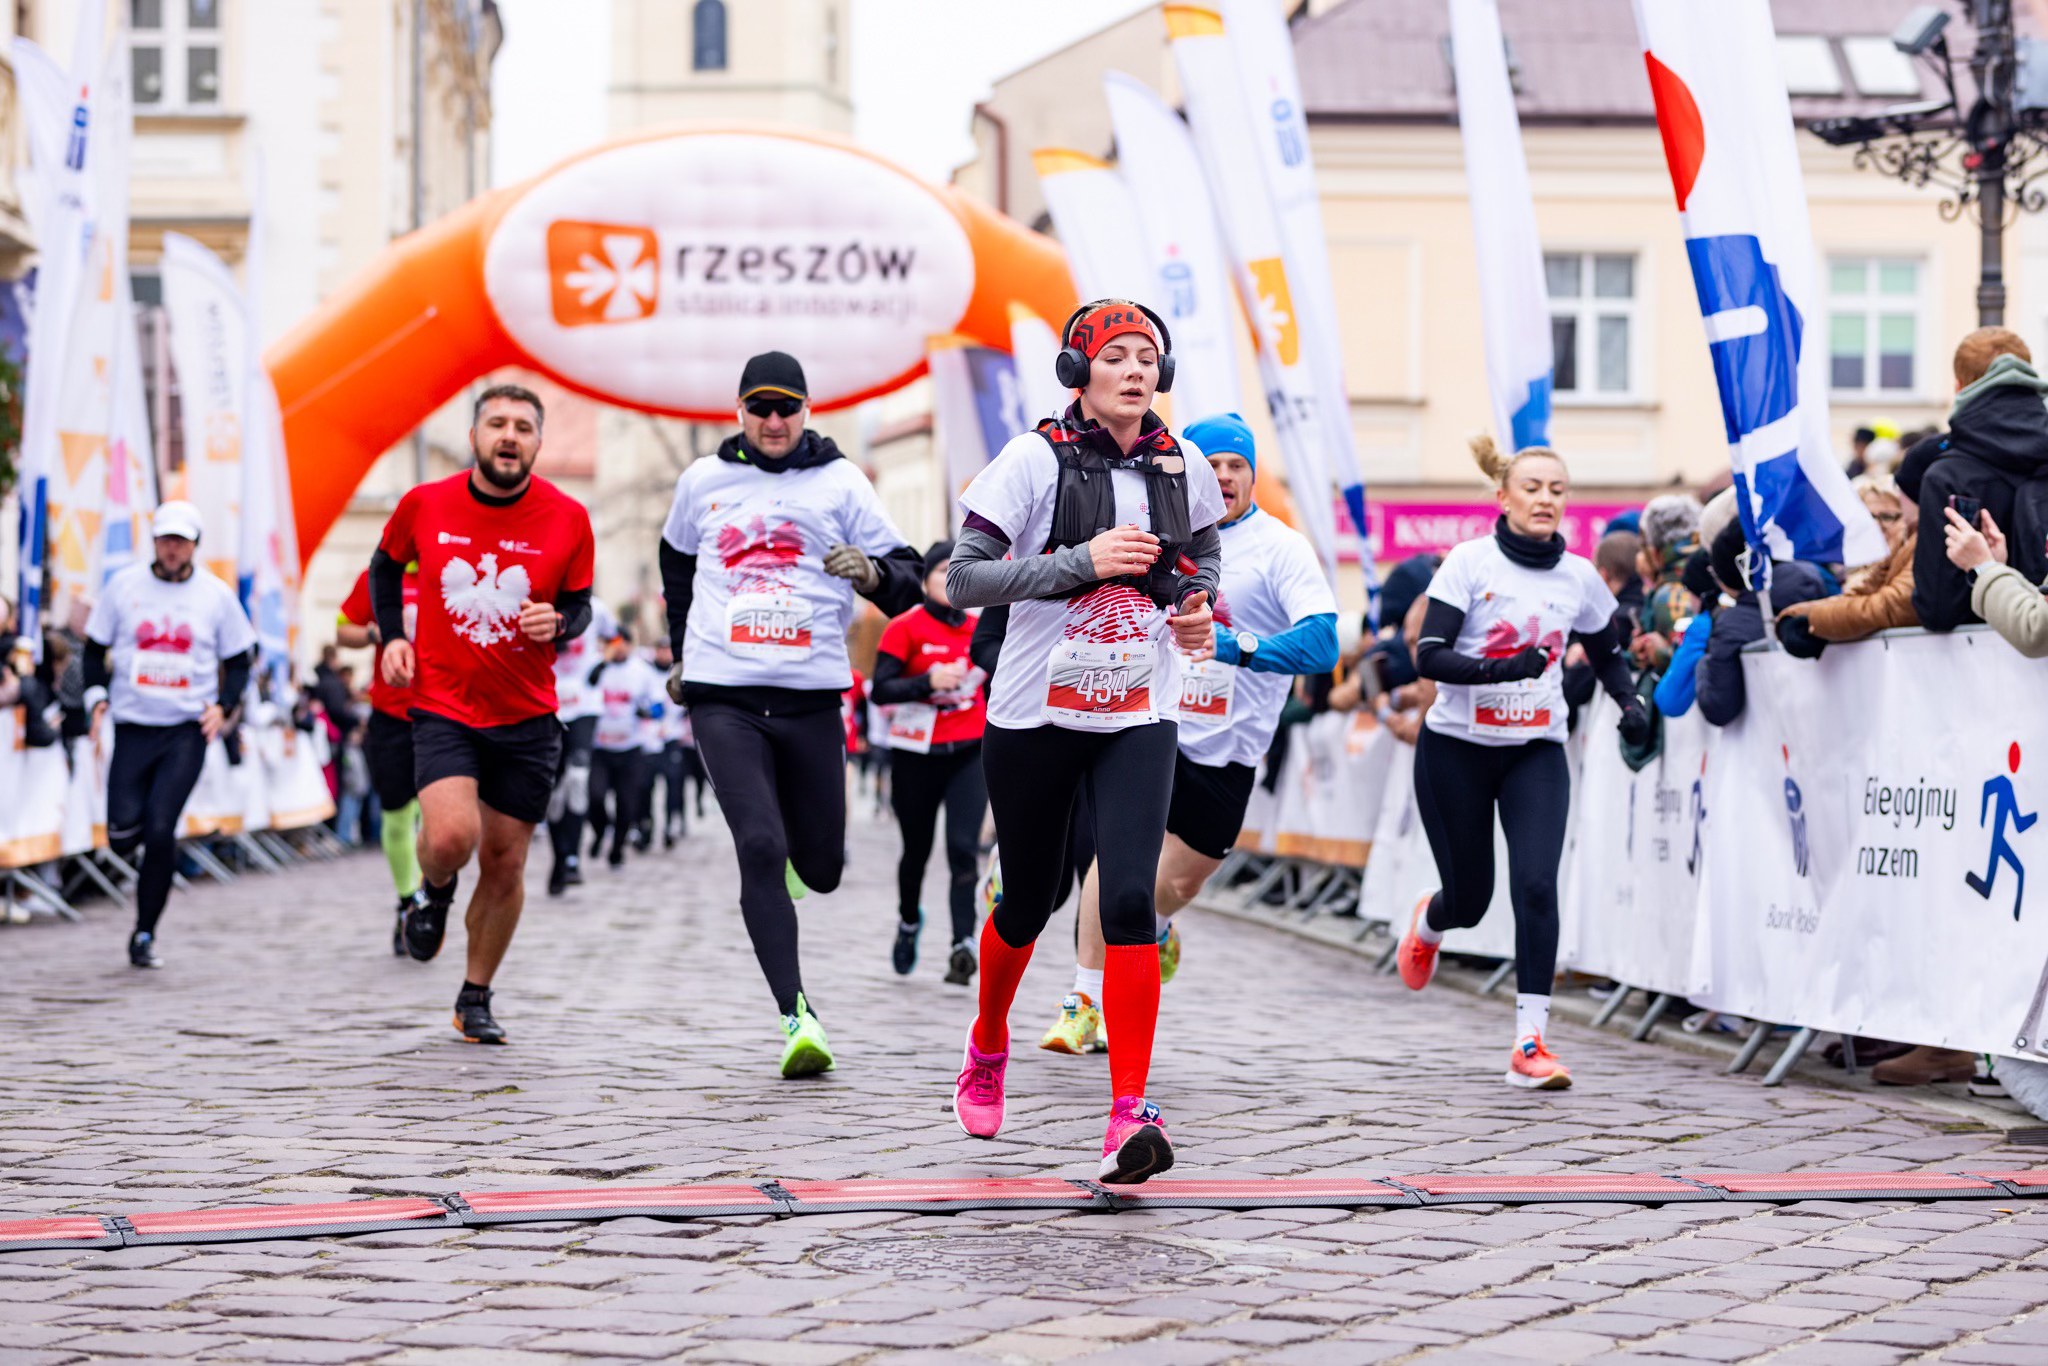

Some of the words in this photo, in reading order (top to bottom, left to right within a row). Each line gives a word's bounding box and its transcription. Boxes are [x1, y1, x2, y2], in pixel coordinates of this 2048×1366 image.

[676, 241, 917, 284] rzeszów
[1076, 668, 1130, 704] 434
[1182, 678, 1213, 707] 06
[1856, 846, 1919, 878] razem
